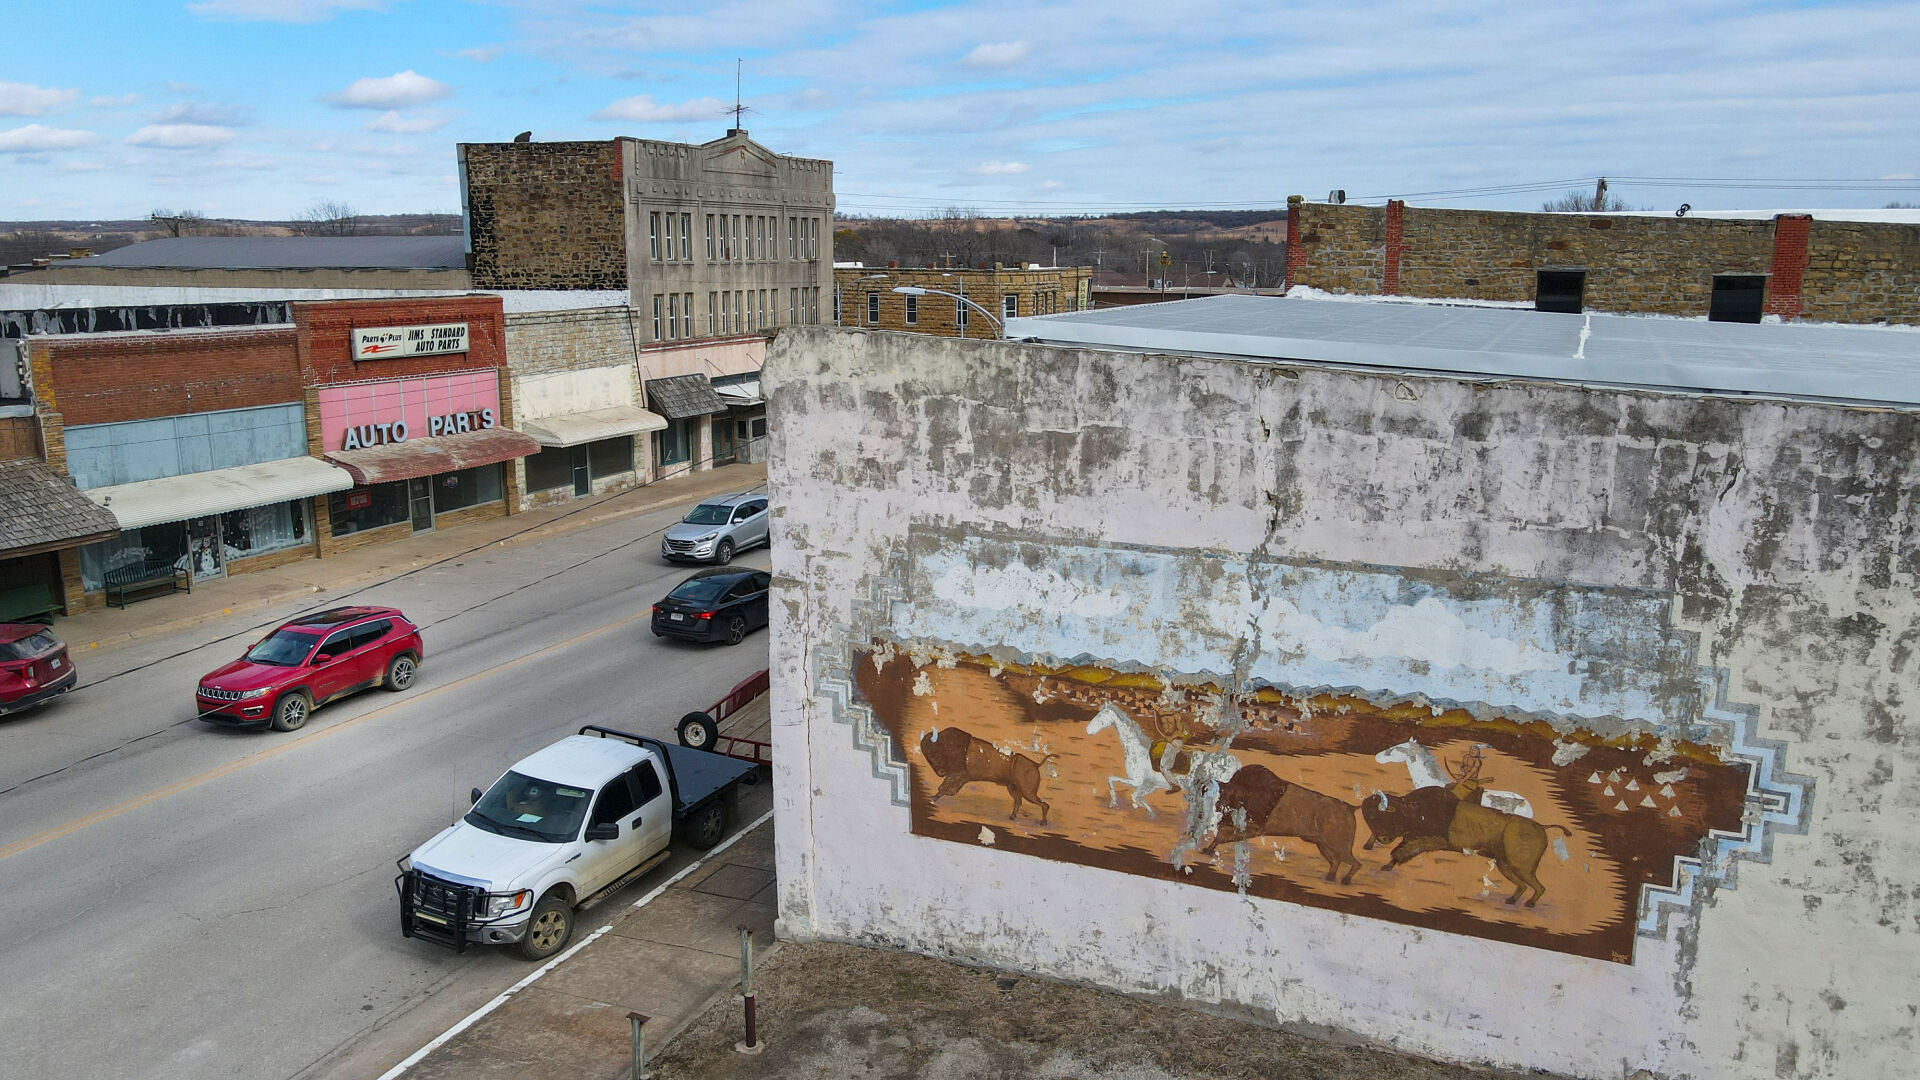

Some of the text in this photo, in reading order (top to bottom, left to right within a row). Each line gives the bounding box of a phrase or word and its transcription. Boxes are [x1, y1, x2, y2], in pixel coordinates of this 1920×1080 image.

[408, 327, 465, 341] JIMS STANDARD
[415, 339, 460, 352] AUTO PARTS
[343, 408, 495, 451] AUTO PARTS
